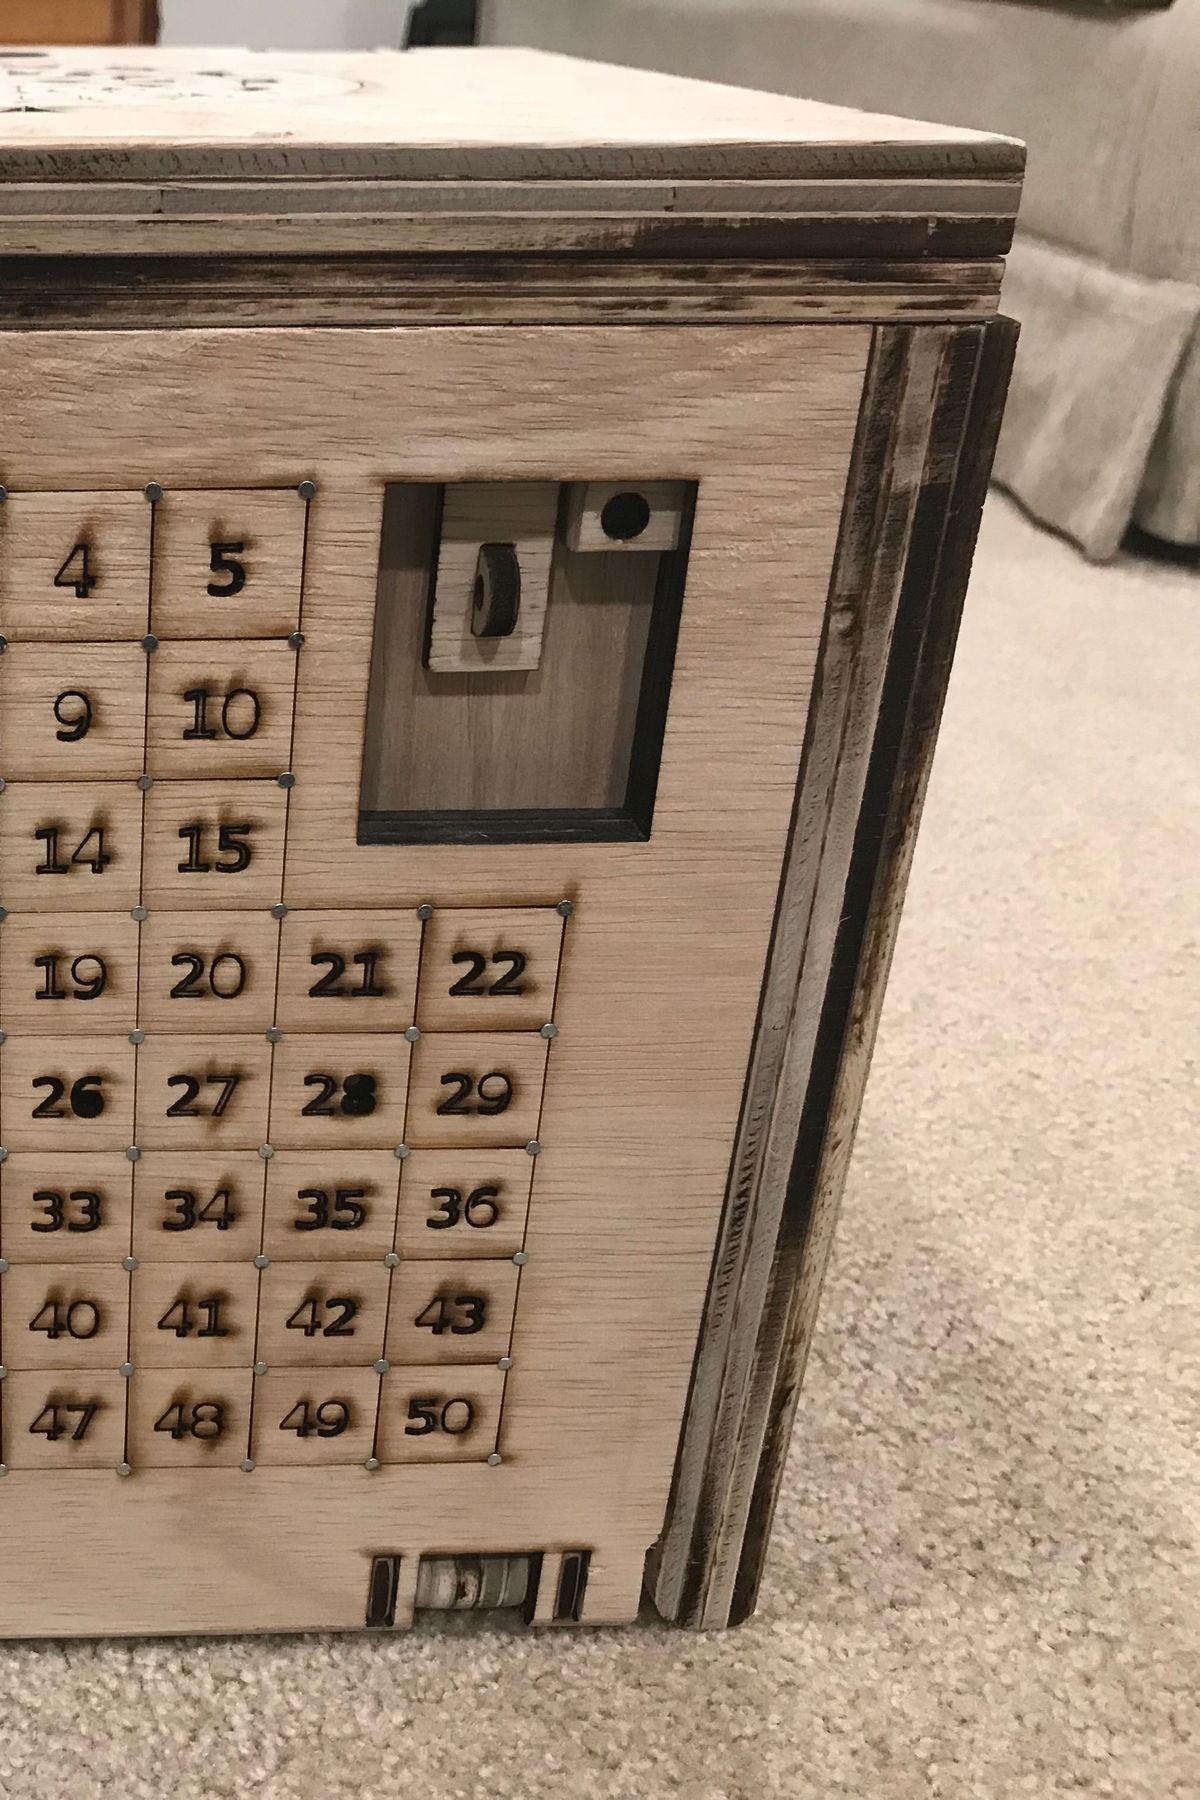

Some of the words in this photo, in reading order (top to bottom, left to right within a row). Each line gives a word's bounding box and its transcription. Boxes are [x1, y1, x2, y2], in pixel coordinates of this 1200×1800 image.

[53, 543, 99, 598] 4
[206, 542, 247, 597] 5
[53, 691, 93, 742] 9
[182, 687, 262, 740] 10
[34, 826, 112, 874] 14
[177, 823, 254, 873] 15
[34, 954, 108, 1000] 19
[170, 953, 247, 999] 20
[308, 949, 389, 997] 21
[448, 951, 529, 996] 22
[31, 1076, 106, 1118] 26
[166, 1074, 243, 1117] 27
[301, 1074, 378, 1116] 28
[436, 1072, 514, 1115] 29
[30, 1191, 102, 1232] 33
[162, 1189, 239, 1231] 34
[293, 1189, 369, 1230] 35
[426, 1186, 501, 1229] 36
[29, 1298, 101, 1339] 40
[157, 1294, 231, 1337] 41
[286, 1296, 359, 1336] 42
[414, 1293, 487, 1334] 43
[29, 1403, 102, 1440] 47
[153, 1400, 229, 1440] 48
[279, 1400, 351, 1437] 49
[404, 1398, 476, 1435] 50
